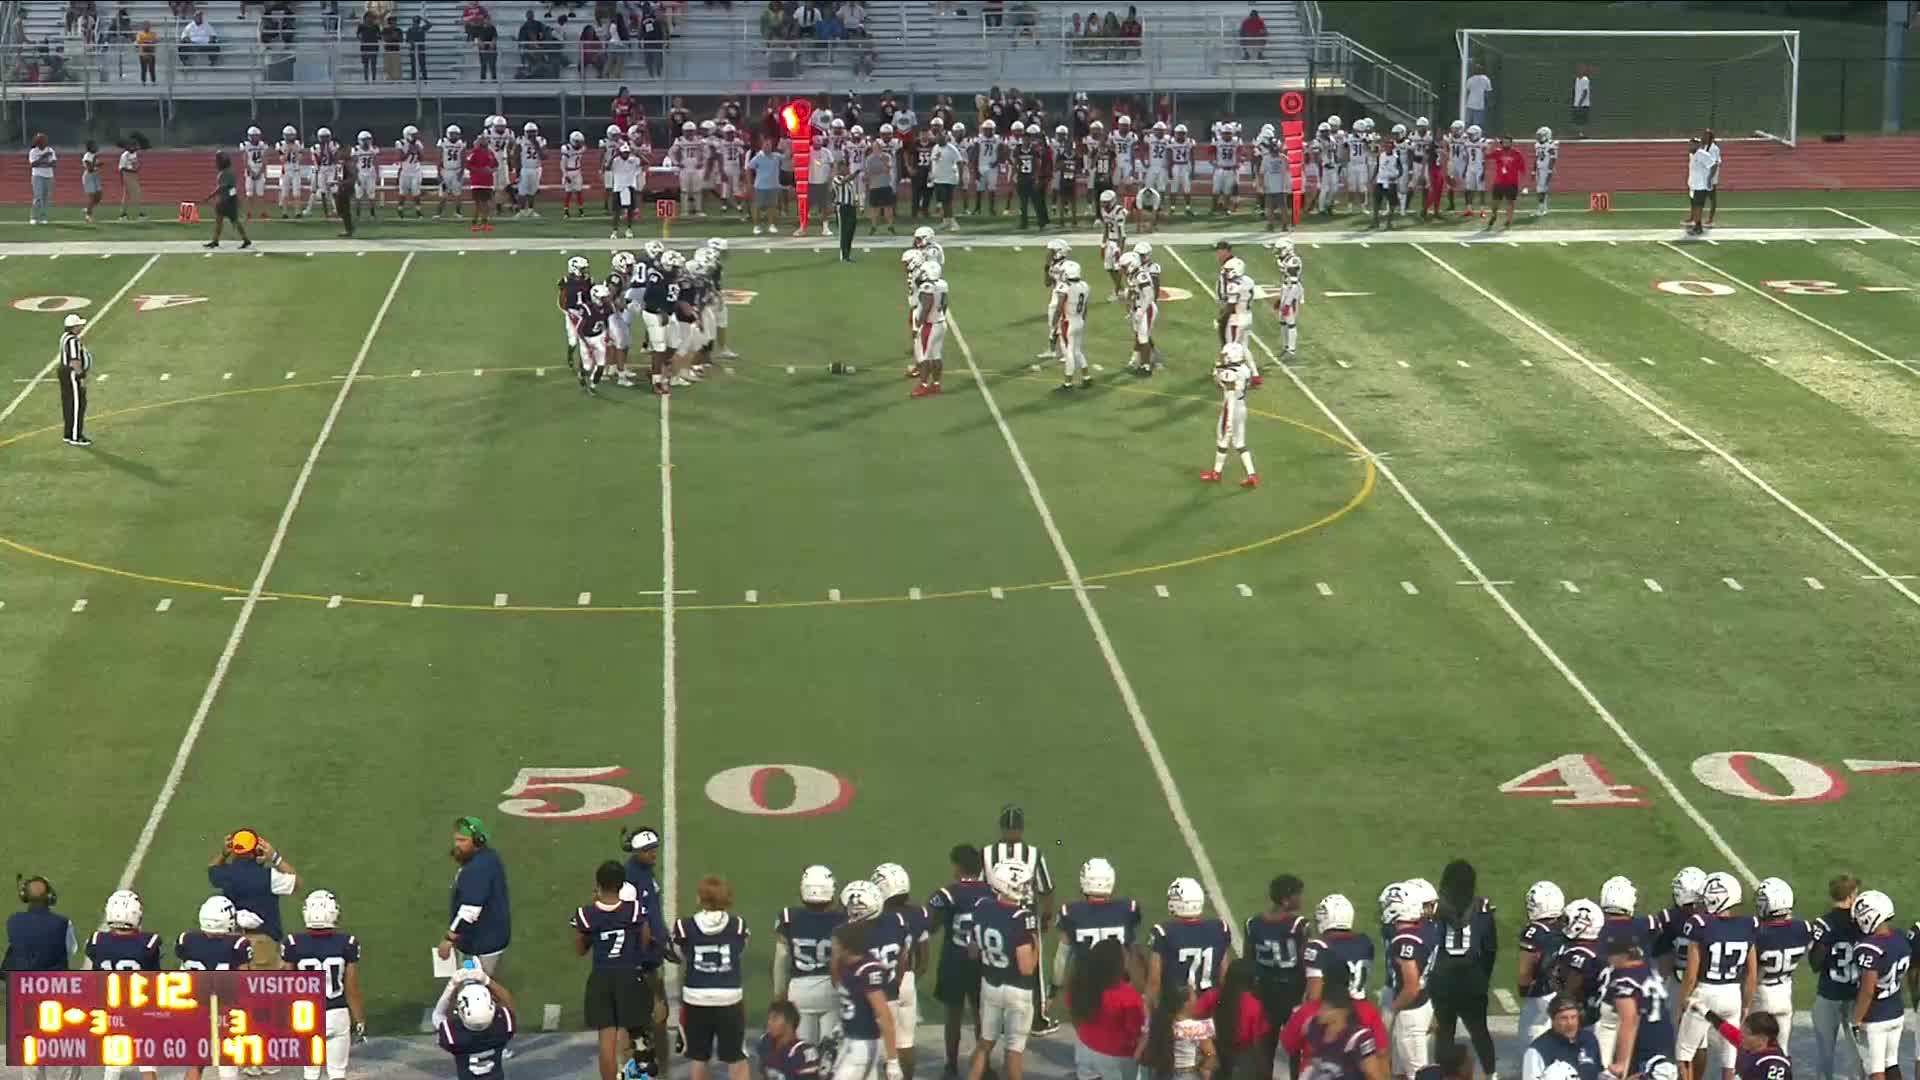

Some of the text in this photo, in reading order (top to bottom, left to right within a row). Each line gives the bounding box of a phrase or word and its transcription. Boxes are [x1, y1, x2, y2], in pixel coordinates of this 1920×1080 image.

[657, 201, 674, 217] 50
[1592, 194, 1608, 209] 30
[497, 765, 853, 819] 50
[1499, 751, 1845, 805] 40
[600, 928, 626, 958] 7
[693, 943, 733, 973] 51
[974, 923, 1010, 969] 18
[1178, 946, 1214, 990] 71
[1706, 941, 1748, 981] 17
[1759, 946, 1806, 985] 25
[1858, 953, 1873, 968] 42
[1767, 1064, 1785, 1080] 22
